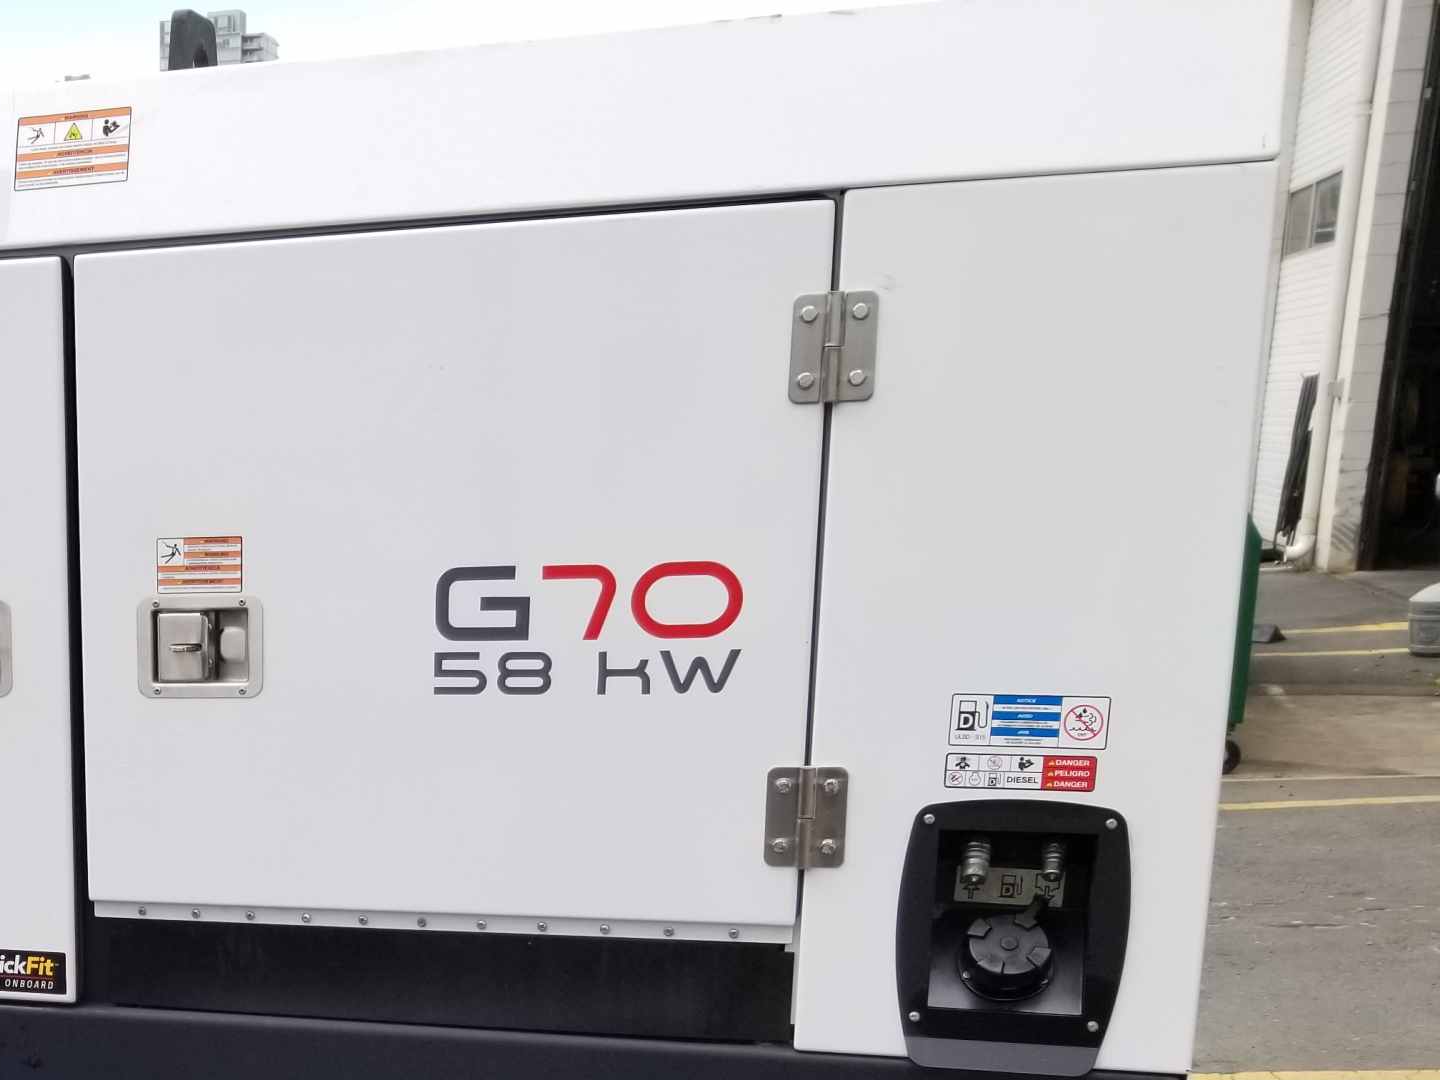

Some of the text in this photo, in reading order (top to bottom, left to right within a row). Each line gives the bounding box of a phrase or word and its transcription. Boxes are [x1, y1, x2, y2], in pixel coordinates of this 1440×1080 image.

[435, 559, 745, 642] G70
[433, 651, 553, 696] 58
[1055, 759, 1090, 767] DANGER
[1006, 776, 1039, 784] DIESEL
[5, 978, 54, 990] ONBOARD
